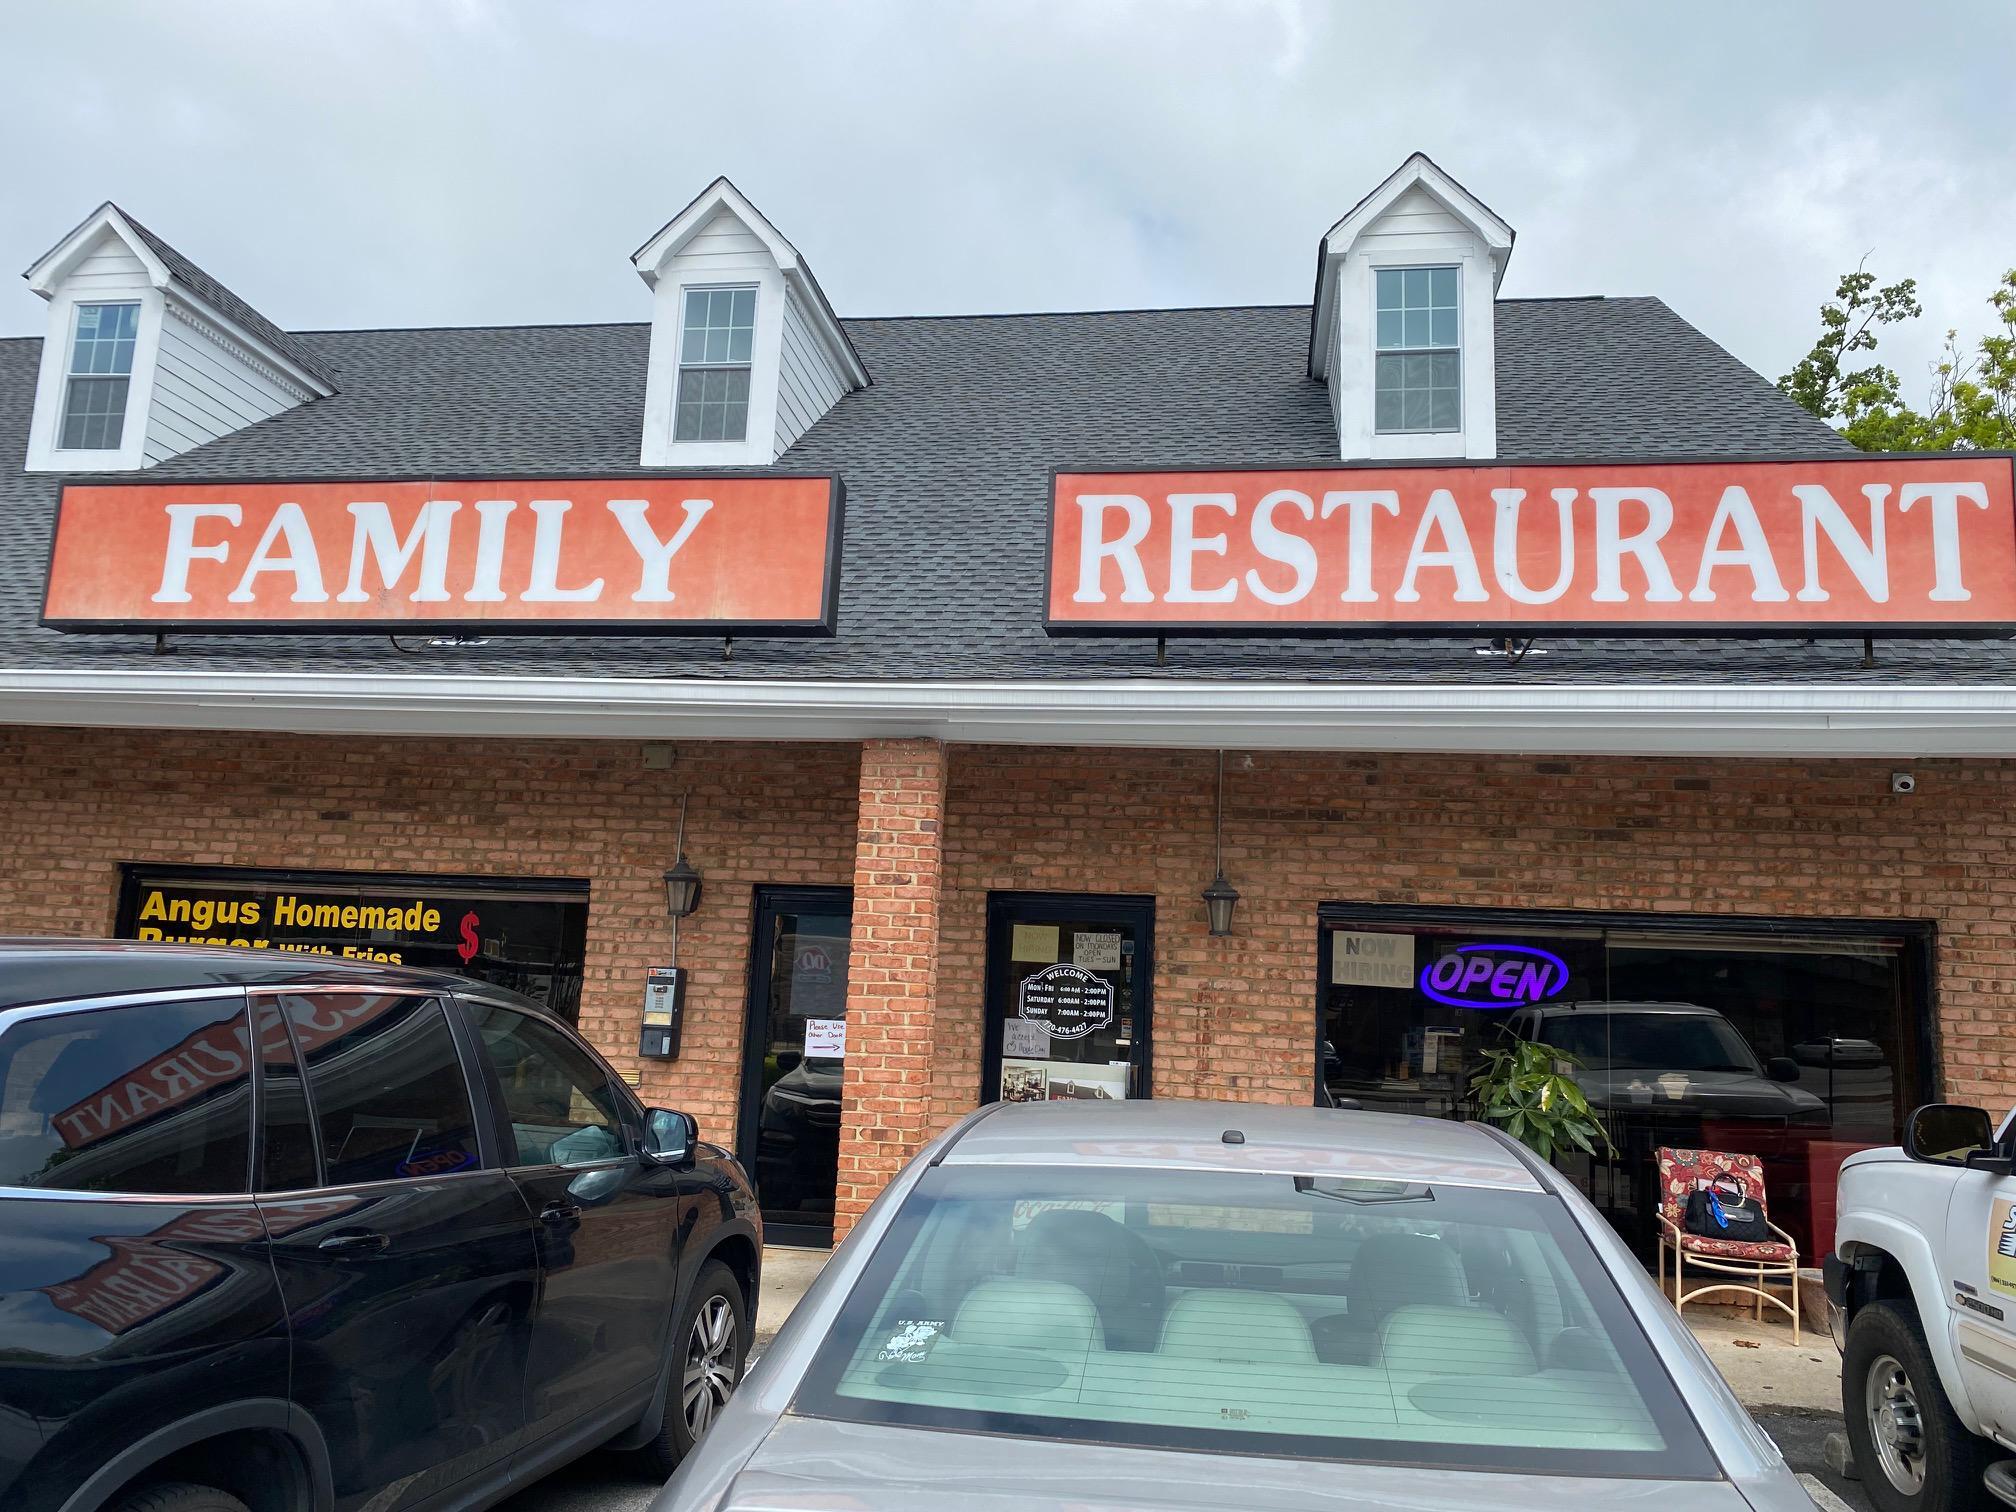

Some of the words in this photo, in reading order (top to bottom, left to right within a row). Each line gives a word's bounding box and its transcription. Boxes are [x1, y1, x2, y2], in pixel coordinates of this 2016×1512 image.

[151, 499, 714, 603] FAMILY
[1072, 481, 1989, 604] RESTAURANT
[139, 891, 260, 931] Angus
[273, 896, 441, 932] Homemade
[1076, 934, 1091, 942] NOW
[1096, 934, 1120, 943] CLOSED
[1346, 938, 1396, 958] NOW
[343, 946, 402, 965] Fries
[1046, 969, 1089, 983] WELCOME
[1431, 954, 1553, 1001] OPEN
